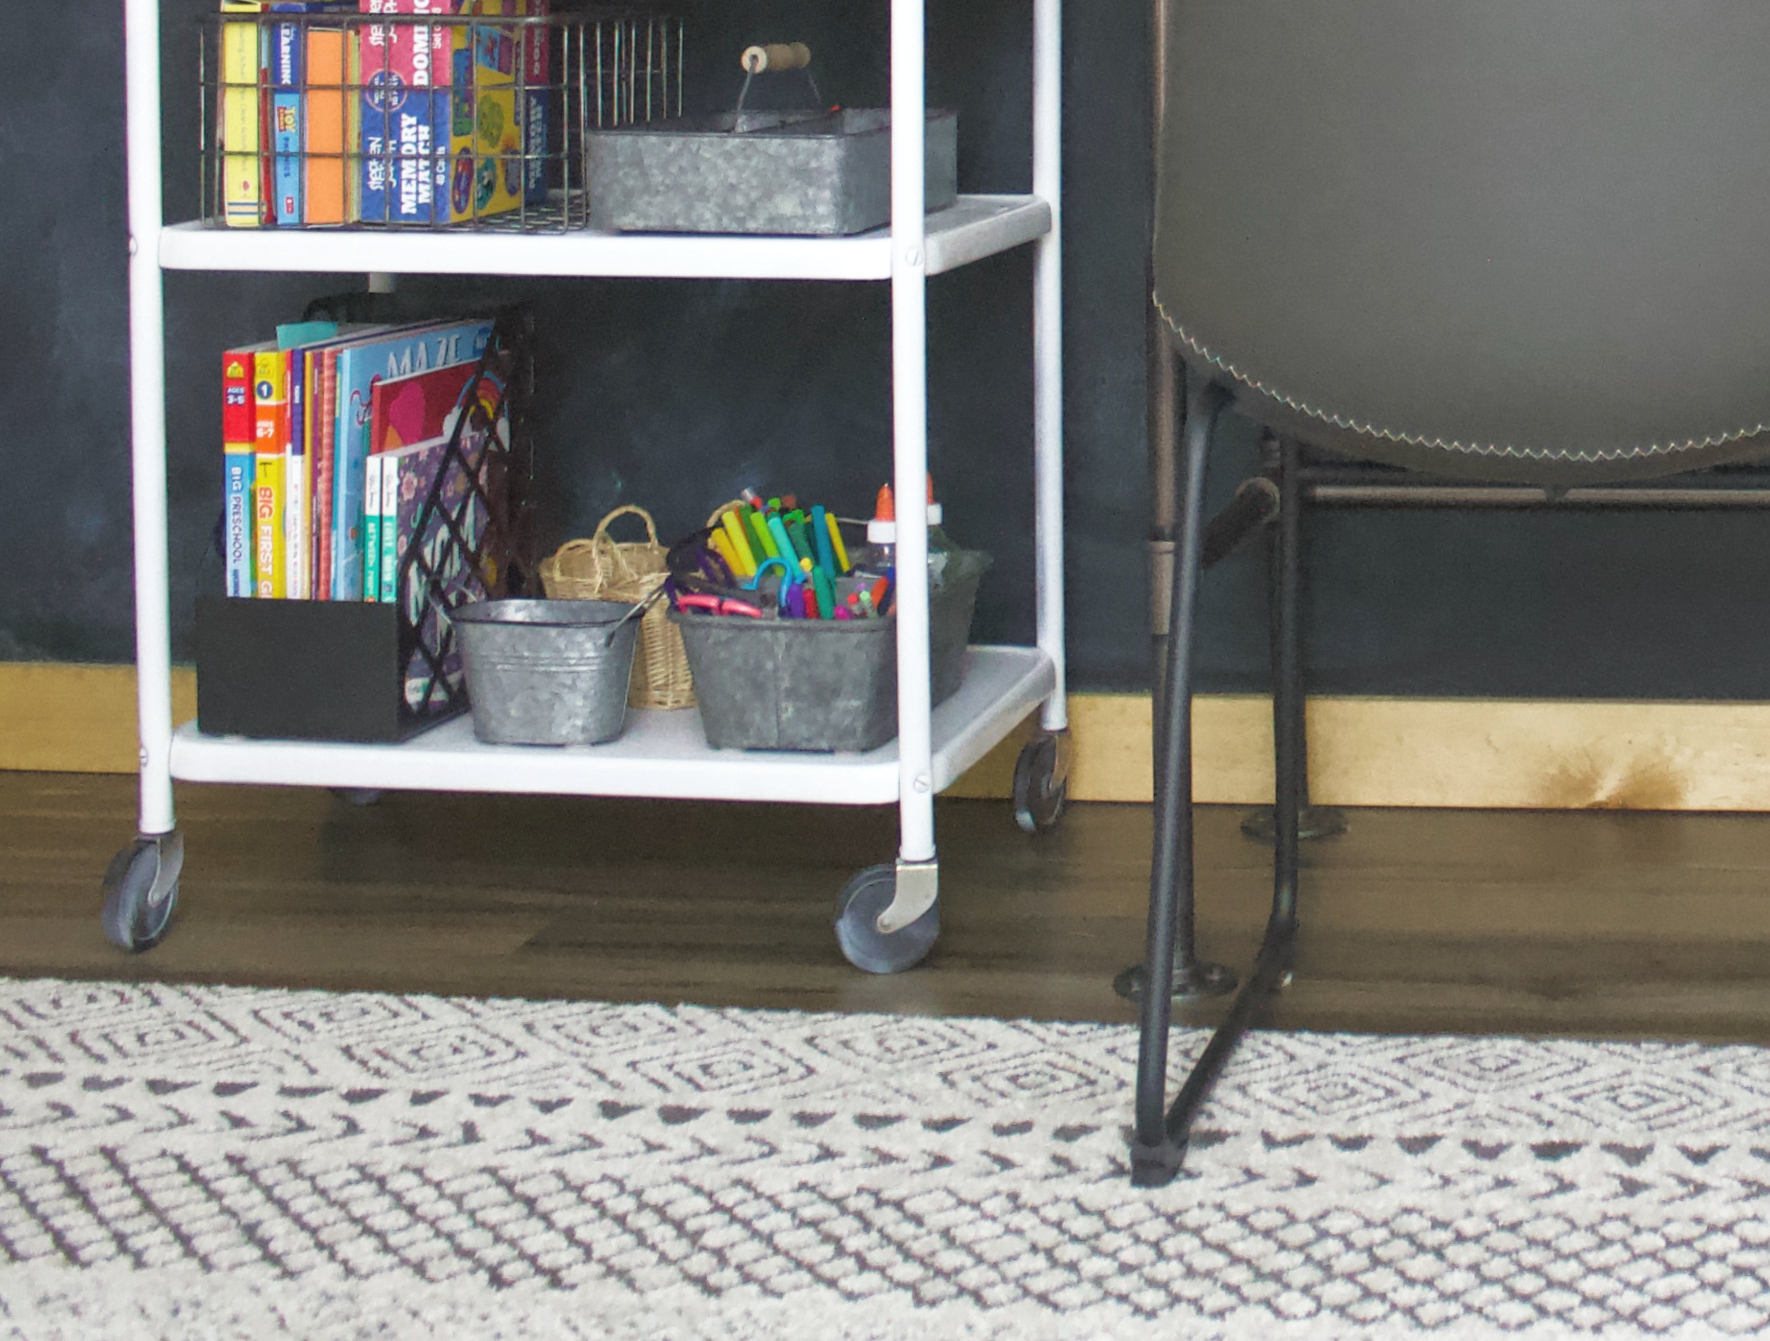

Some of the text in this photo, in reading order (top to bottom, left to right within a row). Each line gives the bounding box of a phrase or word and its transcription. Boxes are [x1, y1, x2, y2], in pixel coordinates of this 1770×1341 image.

[285, 107, 296, 133] TOY
[401, 112, 417, 215] MEMORY
[387, 333, 462, 380] MAZE
[227, 386, 245, 394] AGES
[227, 395, 245, 405] 3-5
[262, 385, 269, 398] 1
[256, 427, 275, 439] 6-7
[231, 466, 243, 492] BIG
[258, 486, 274, 520] BIG
[231, 495, 243, 564] PRESCHOOL
[259, 523, 274, 576] FIRST
